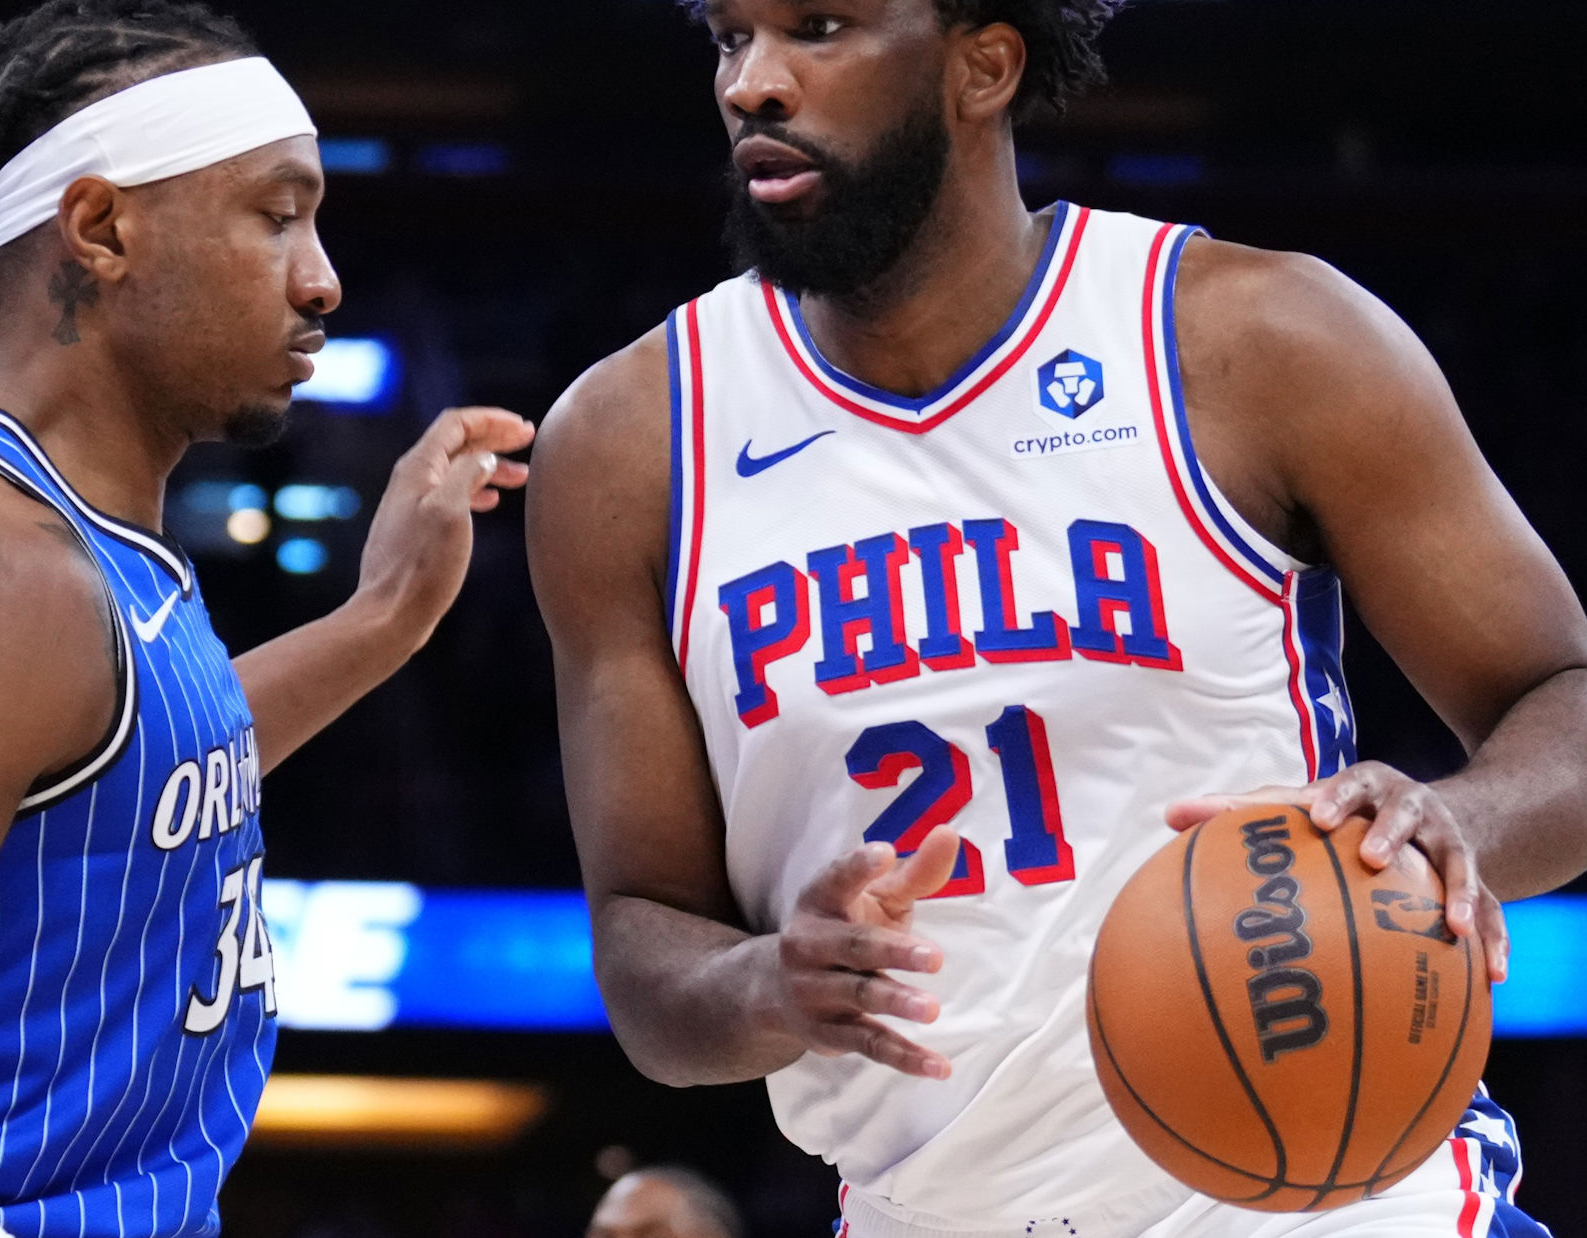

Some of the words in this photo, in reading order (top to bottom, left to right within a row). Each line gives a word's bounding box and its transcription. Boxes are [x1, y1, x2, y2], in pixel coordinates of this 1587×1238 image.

[1014, 425, 1138, 454] crypto.com
[717, 518, 1184, 729] PHILA
[844, 704, 1076, 899] 21
[182, 852, 278, 1037] 34
[1234, 814, 1330, 1065] Wilson
